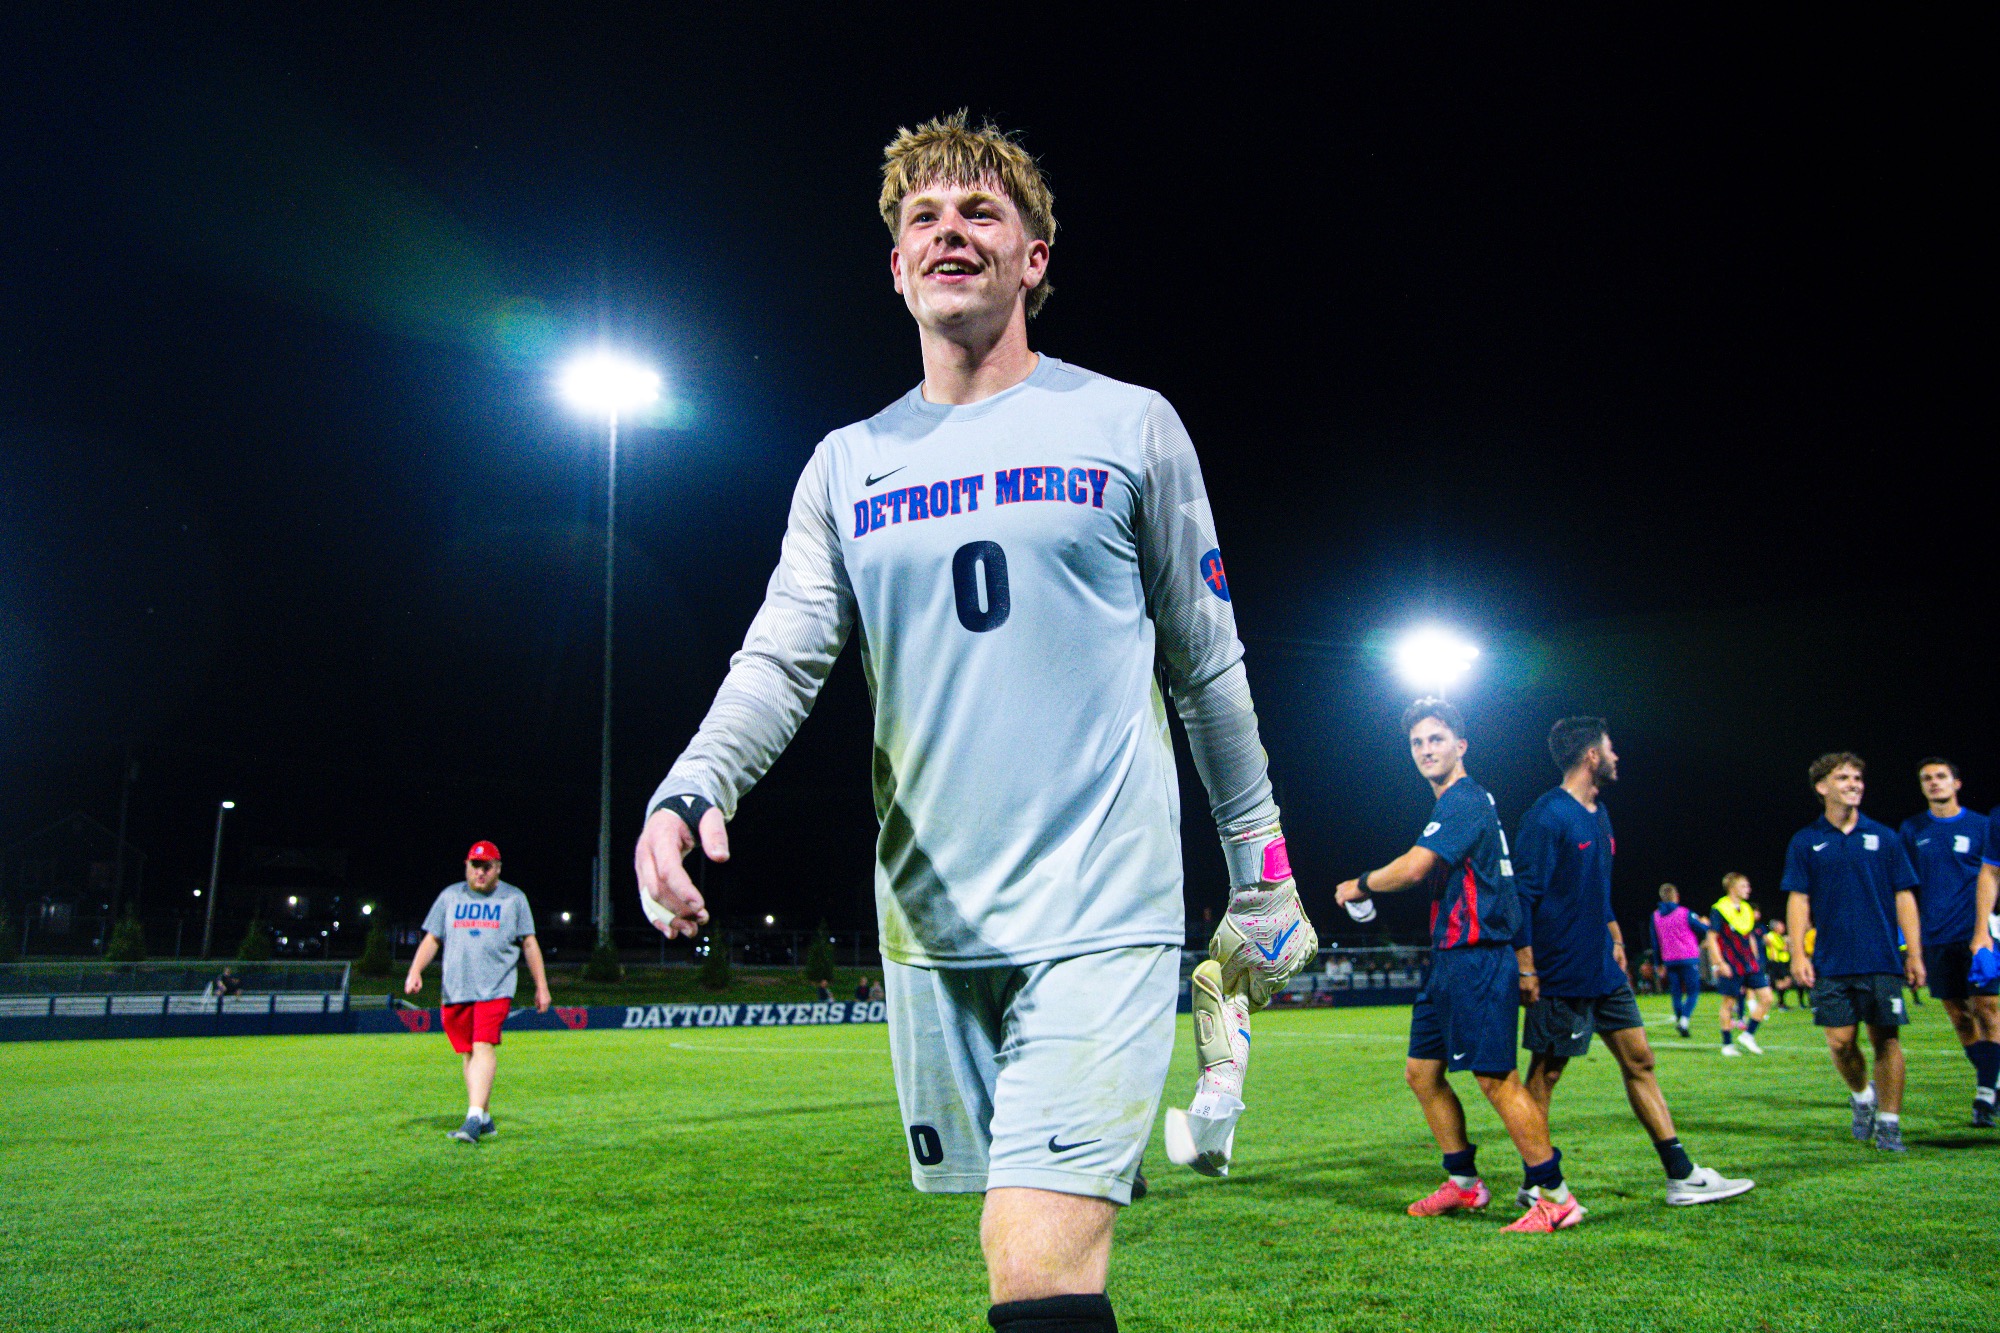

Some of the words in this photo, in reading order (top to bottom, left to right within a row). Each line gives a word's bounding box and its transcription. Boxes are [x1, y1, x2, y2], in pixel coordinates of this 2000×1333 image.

[854, 474, 984, 539] DETROIT
[995, 466, 1109, 508] MERCY
[952, 540, 1011, 632] 0
[454, 903, 501, 920] UDM
[622, 1006, 738, 1028] DAYTON
[742, 1003, 845, 1025] FLYERS
[850, 1001, 888, 1022] SO
[910, 1125, 943, 1165] 0
